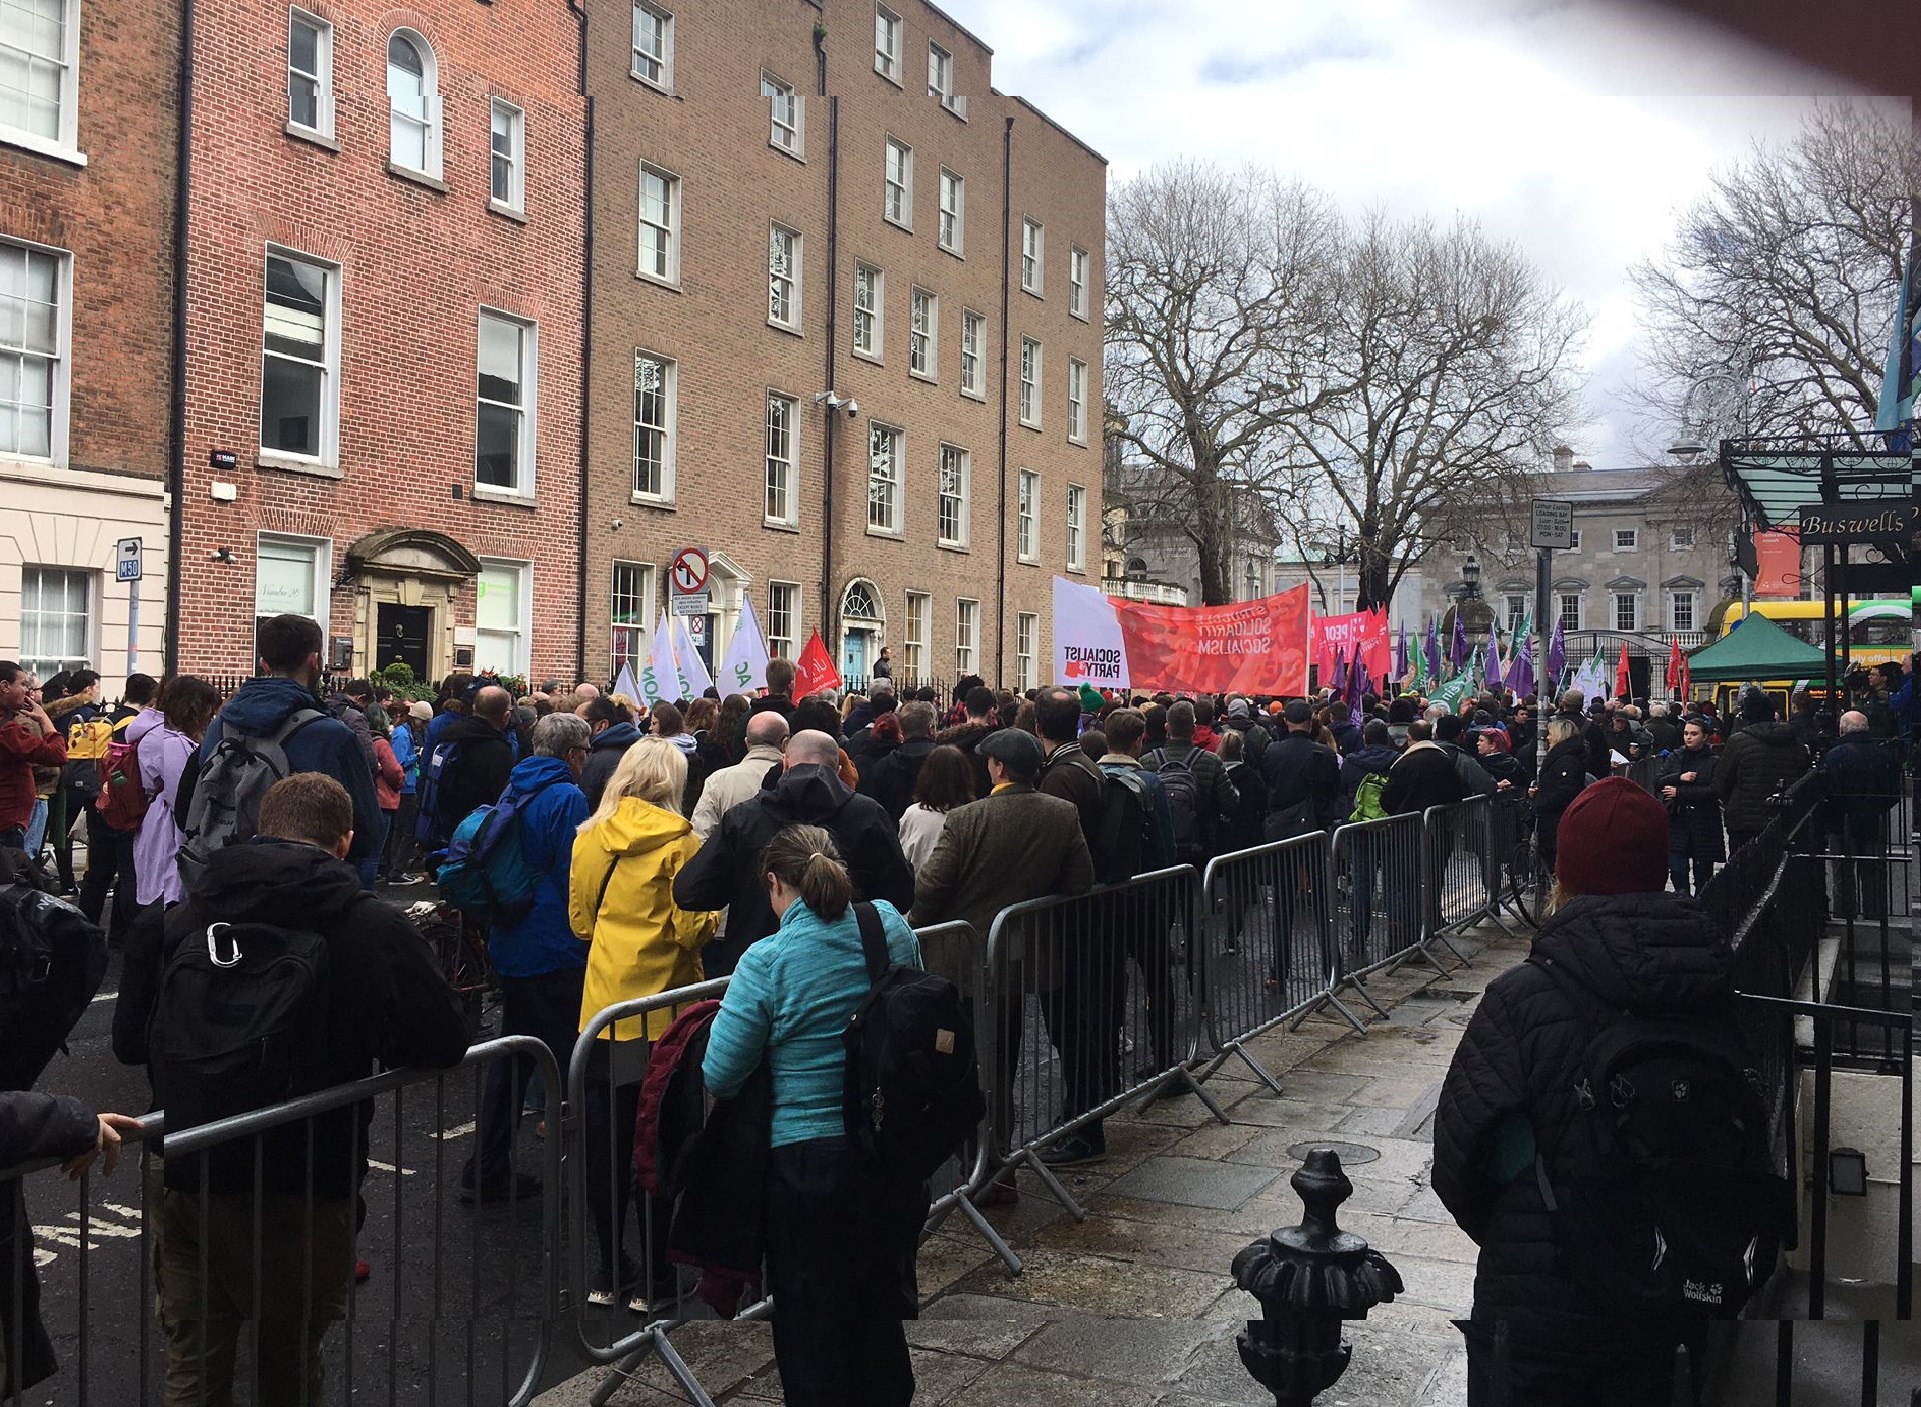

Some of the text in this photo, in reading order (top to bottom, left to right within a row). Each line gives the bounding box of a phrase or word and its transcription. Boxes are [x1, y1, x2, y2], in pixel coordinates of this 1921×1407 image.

[1802, 510, 1905, 535] Buswells
[120, 561, 138, 577] M50
[1683, 1279, 1706, 1291] Jack
[1683, 1287, 1722, 1304] Wolfskin
